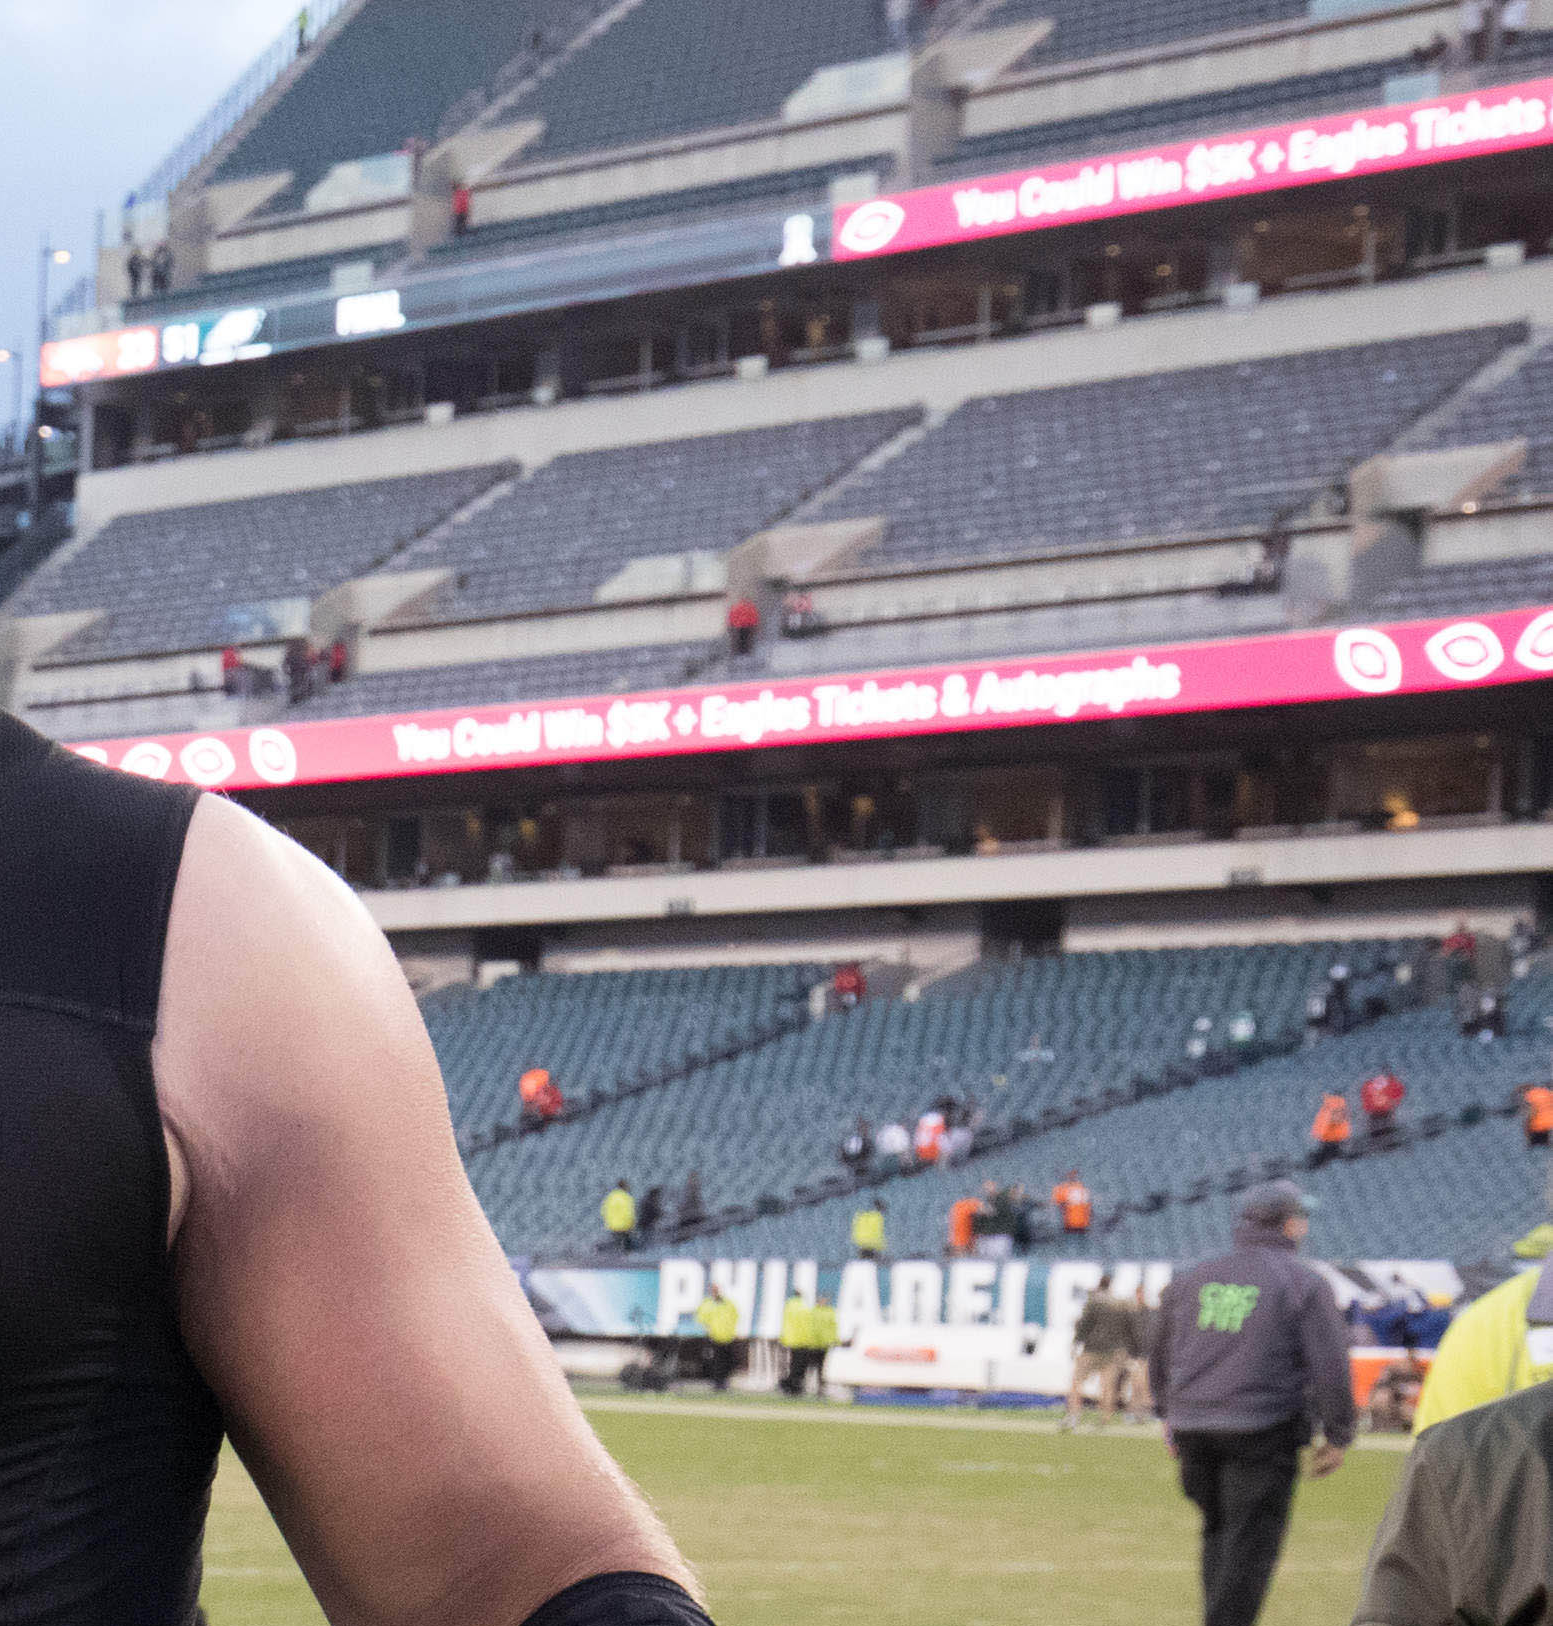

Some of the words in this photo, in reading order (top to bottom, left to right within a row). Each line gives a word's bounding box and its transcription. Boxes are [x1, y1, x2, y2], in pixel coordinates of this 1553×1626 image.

[953, 187, 1016, 228] You
[1019, 162, 1115, 217] Could
[1116, 155, 1182, 201] Win
[1287, 119, 1408, 173] Eagles
[1410, 97, 1547, 151] Tickets
[393, 723, 451, 762] You
[452, 711, 542, 758] Could
[543, 708, 604, 749] Win
[699, 690, 811, 743] Eagles
[812, 680, 938, 727] Tickets
[940, 674, 971, 717] &
[972, 656, 1181, 718] Autographs
